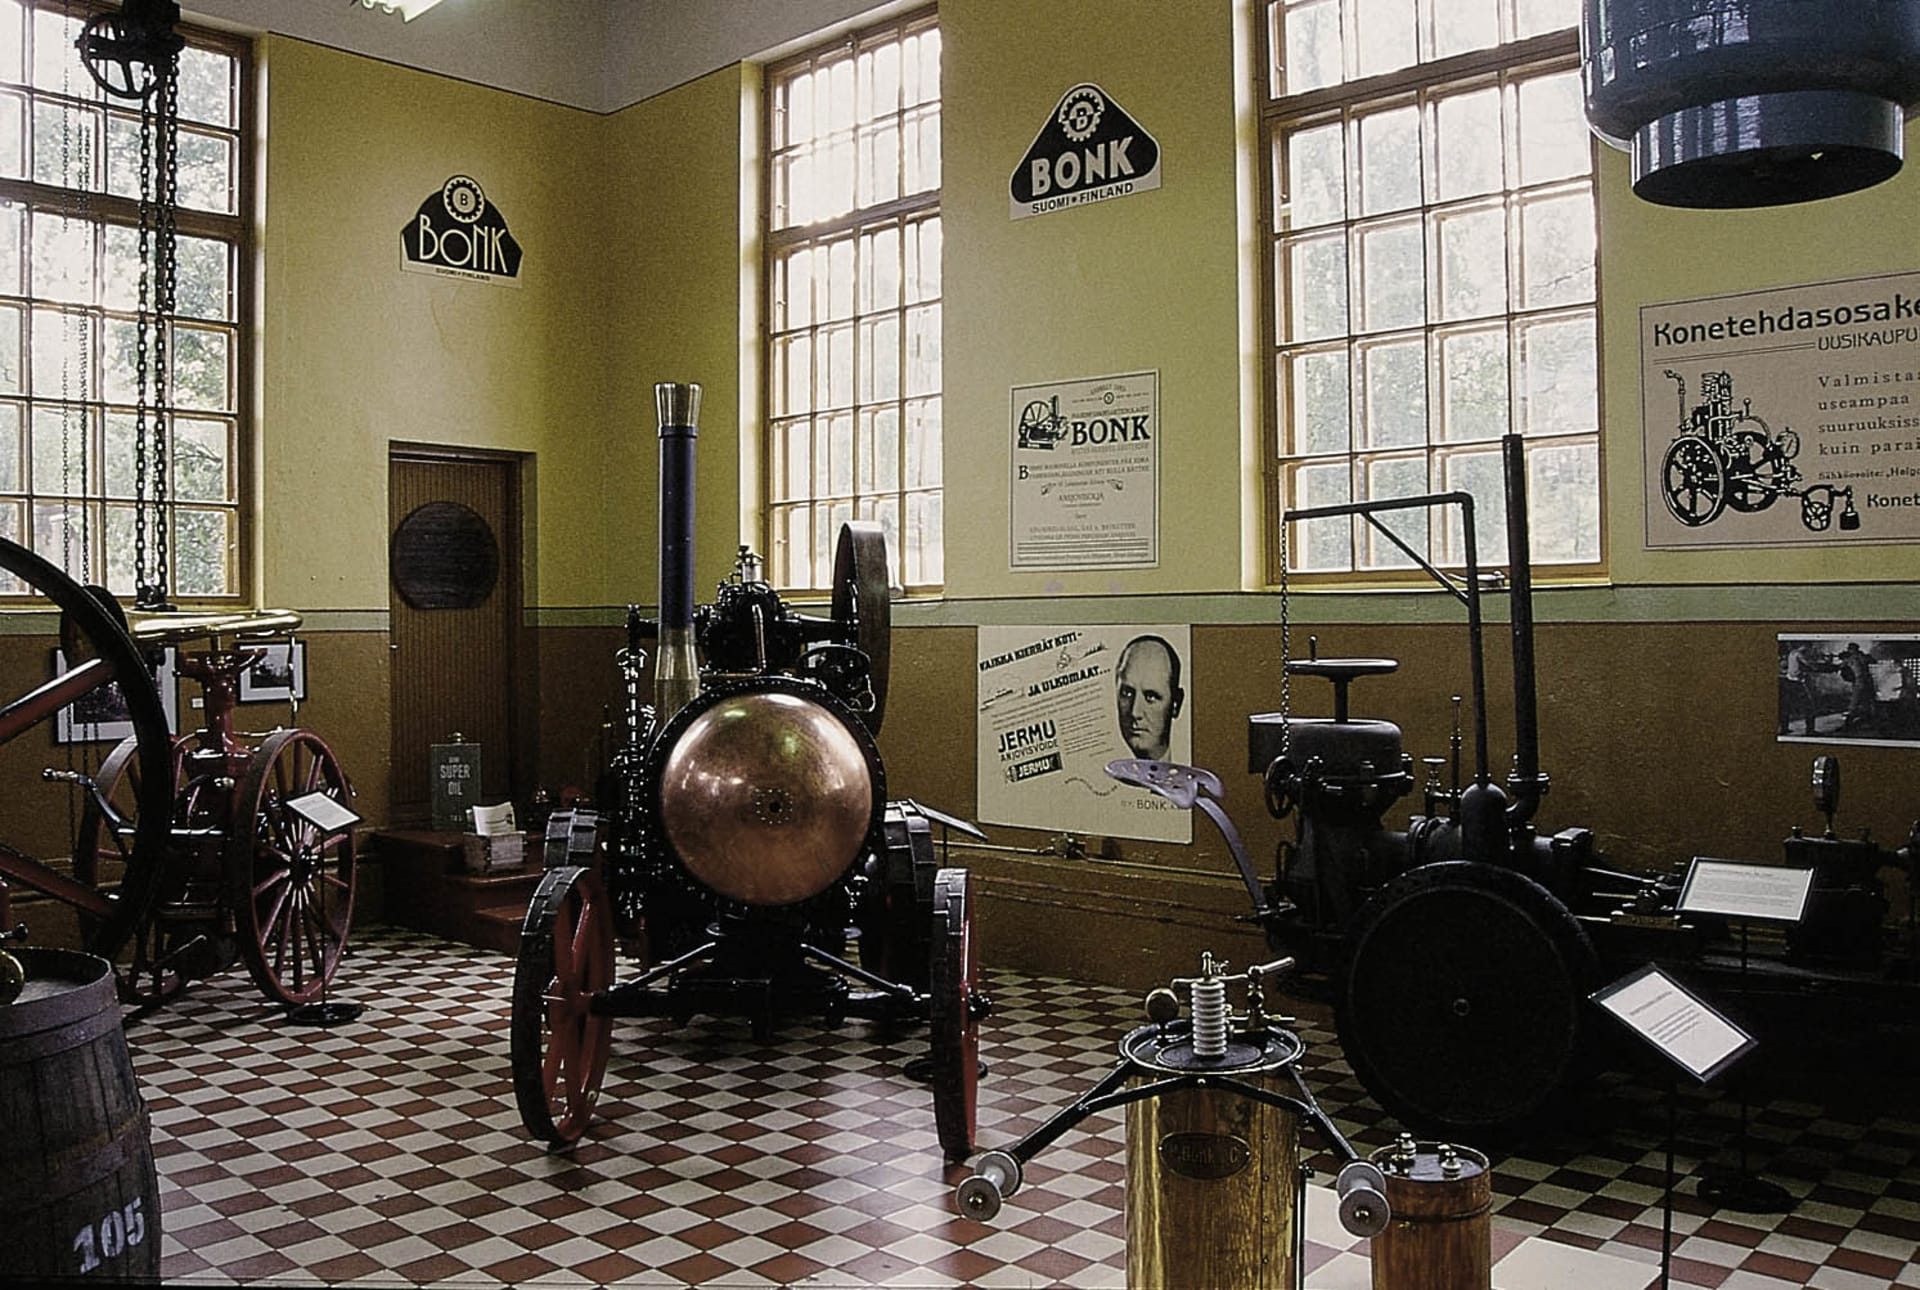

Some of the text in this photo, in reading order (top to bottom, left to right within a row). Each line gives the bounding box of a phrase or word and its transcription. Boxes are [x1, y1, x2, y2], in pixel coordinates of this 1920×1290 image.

[1031, 136, 1135, 197] BONK
[1032, 182, 1133, 214] SUOMI FINLAND
[420, 214, 507, 274] BONK
[1818, 395, 1909, 411] useampaa
[1071, 415, 1150, 446] BONK
[1819, 441, 1860, 455] kuin
[979, 653, 1015, 672] VAIKKA
[1028, 684, 1041, 697] JA
[998, 719, 1057, 753] JERMU
[440, 764, 471, 779] SUPER
[1018, 757, 1050, 778] JERMU
[448, 781, 463, 796] OIL
[1136, 799, 1167, 810] BONK
[73, 1196, 145, 1274] 105
